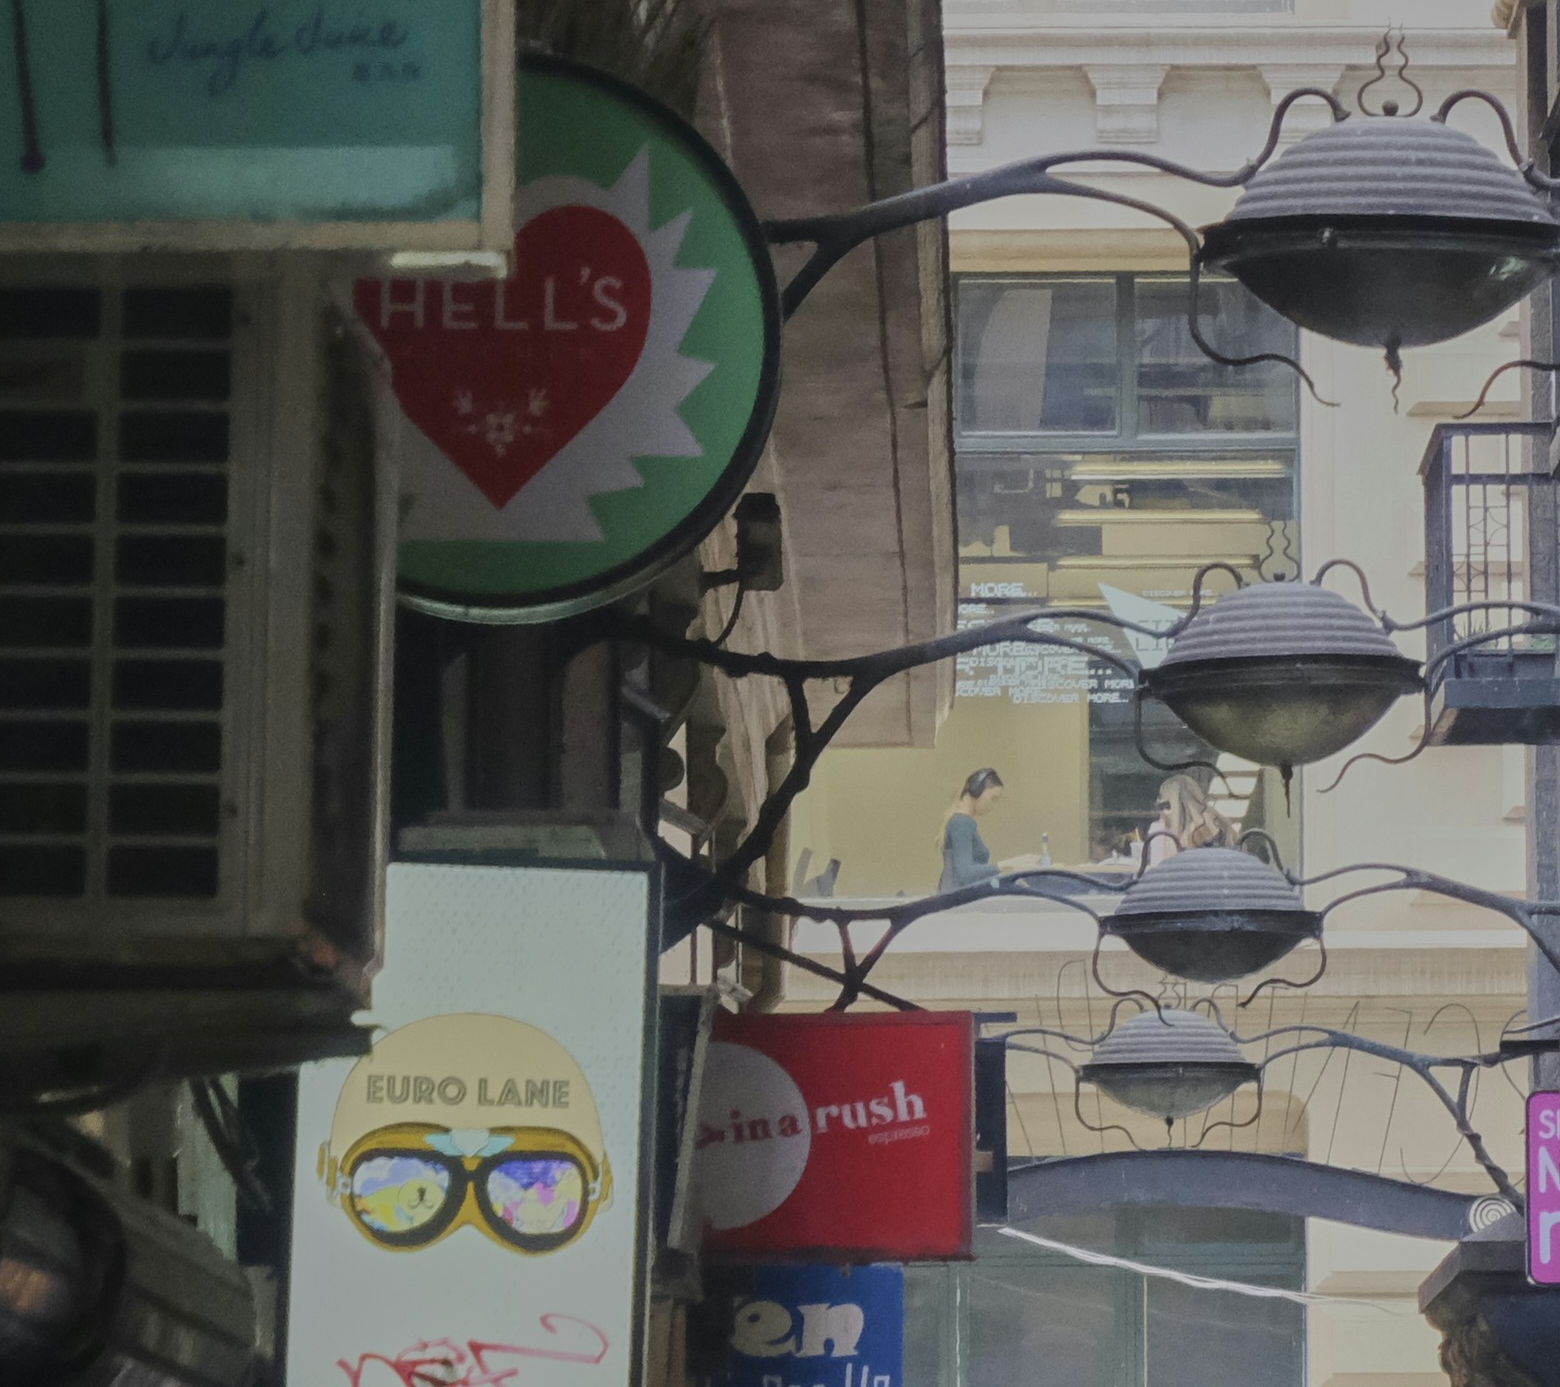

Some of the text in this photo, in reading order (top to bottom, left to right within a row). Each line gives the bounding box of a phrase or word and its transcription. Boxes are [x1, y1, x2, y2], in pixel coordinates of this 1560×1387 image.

[380, 266, 628, 330] HELL'S
[366, 1074, 571, 1109] EURO LANE
[815, 1079, 928, 1134] rush
